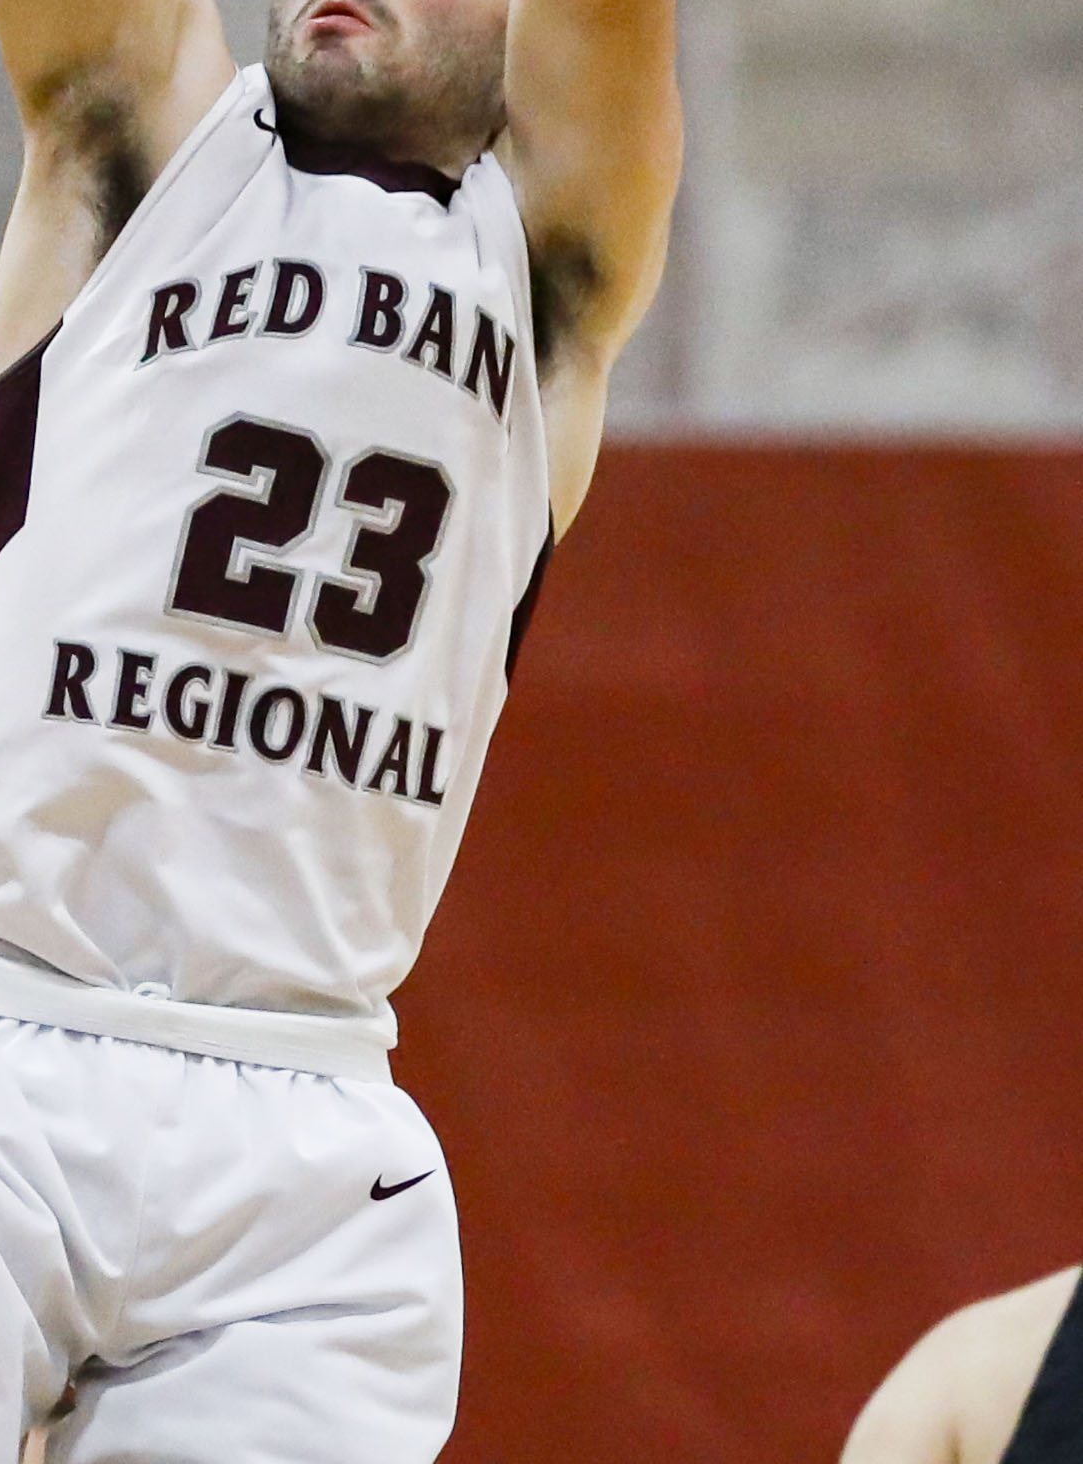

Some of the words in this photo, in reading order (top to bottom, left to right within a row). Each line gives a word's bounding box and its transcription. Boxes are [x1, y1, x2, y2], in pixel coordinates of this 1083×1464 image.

[134, 257, 328, 370] RED
[164, 410, 457, 666] 23
[41, 638, 451, 809] REGIONAL
